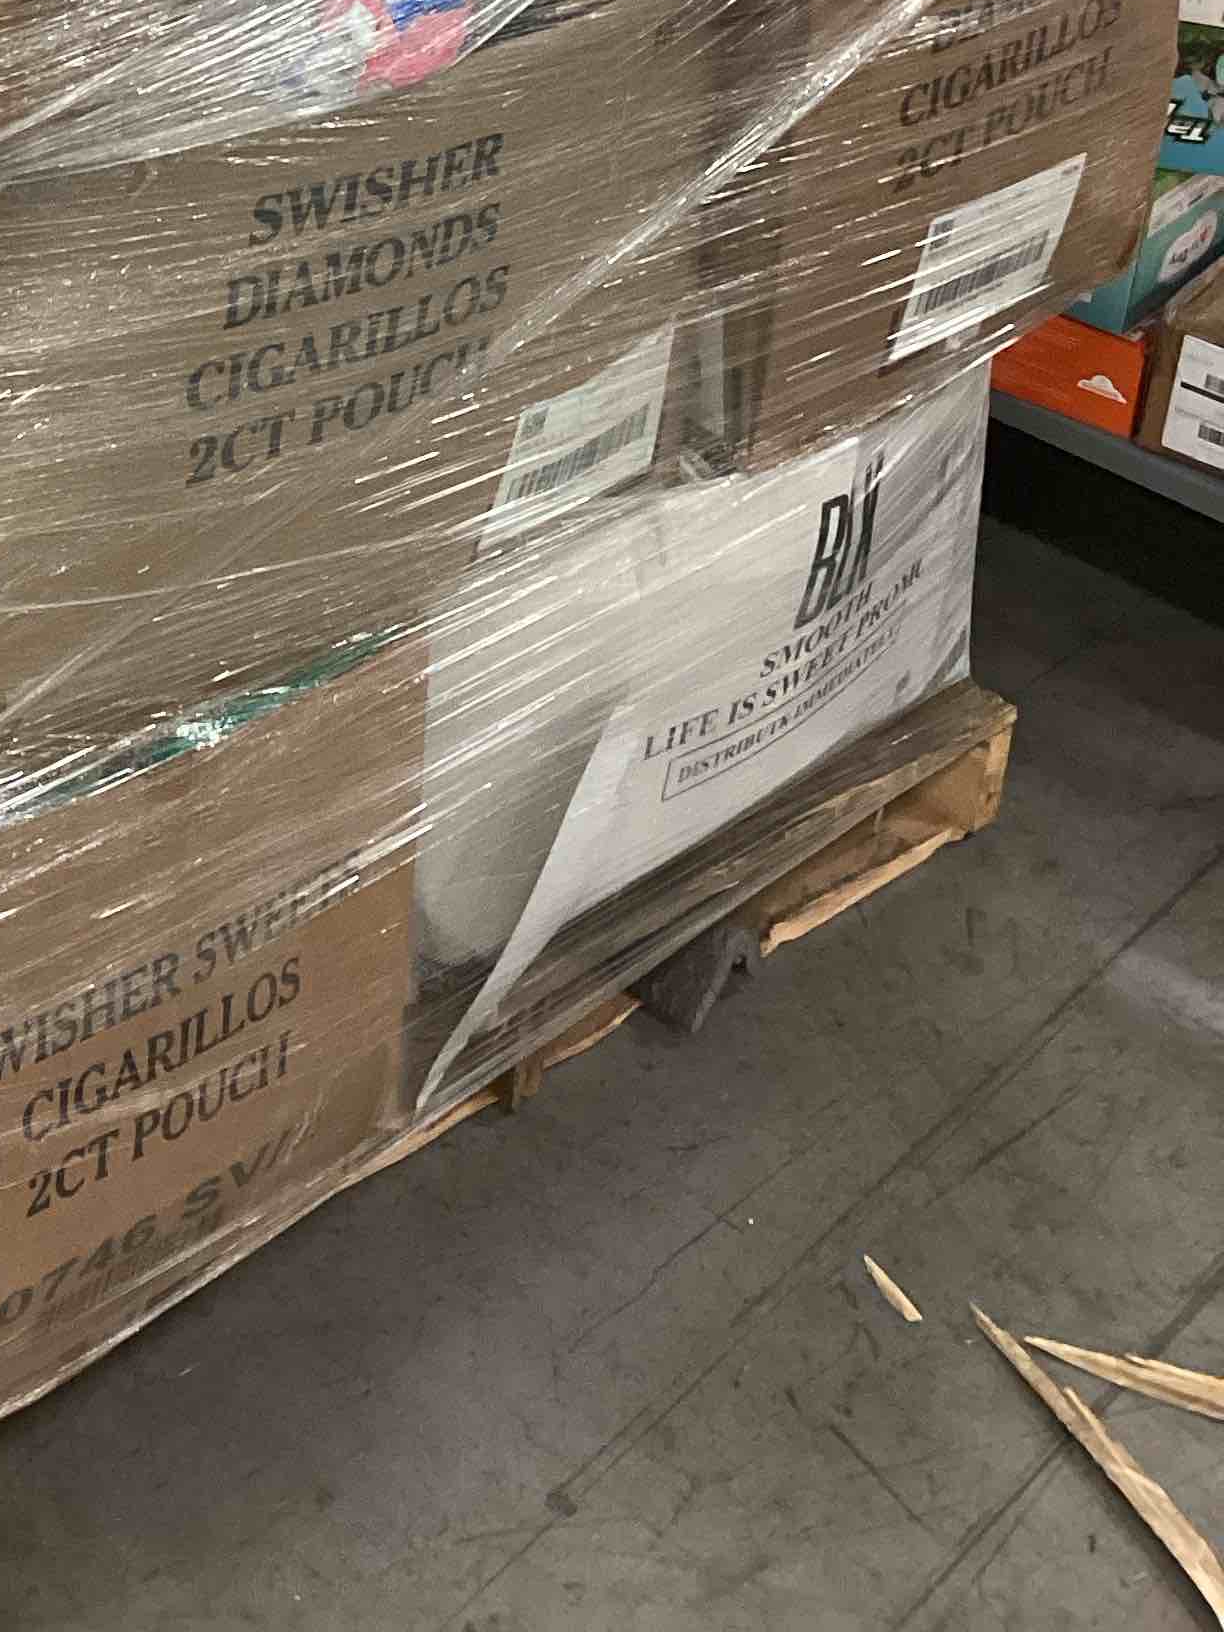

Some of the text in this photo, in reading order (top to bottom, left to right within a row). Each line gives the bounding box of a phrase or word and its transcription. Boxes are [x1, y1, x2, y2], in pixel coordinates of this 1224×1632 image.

[249, 132, 505, 247] SWISHER
[224, 203, 502, 330] DIAMONDS
[186, 265, 511, 412] CIGARILLOS
[185, 407, 295, 489] 2CT
[643, 708, 720, 761] LIFE
[728, 692, 758, 725] IS
[22, 956, 302, 1143] CIGARILLOS
[25, 1029, 293, 1218] 2CT POUCH
